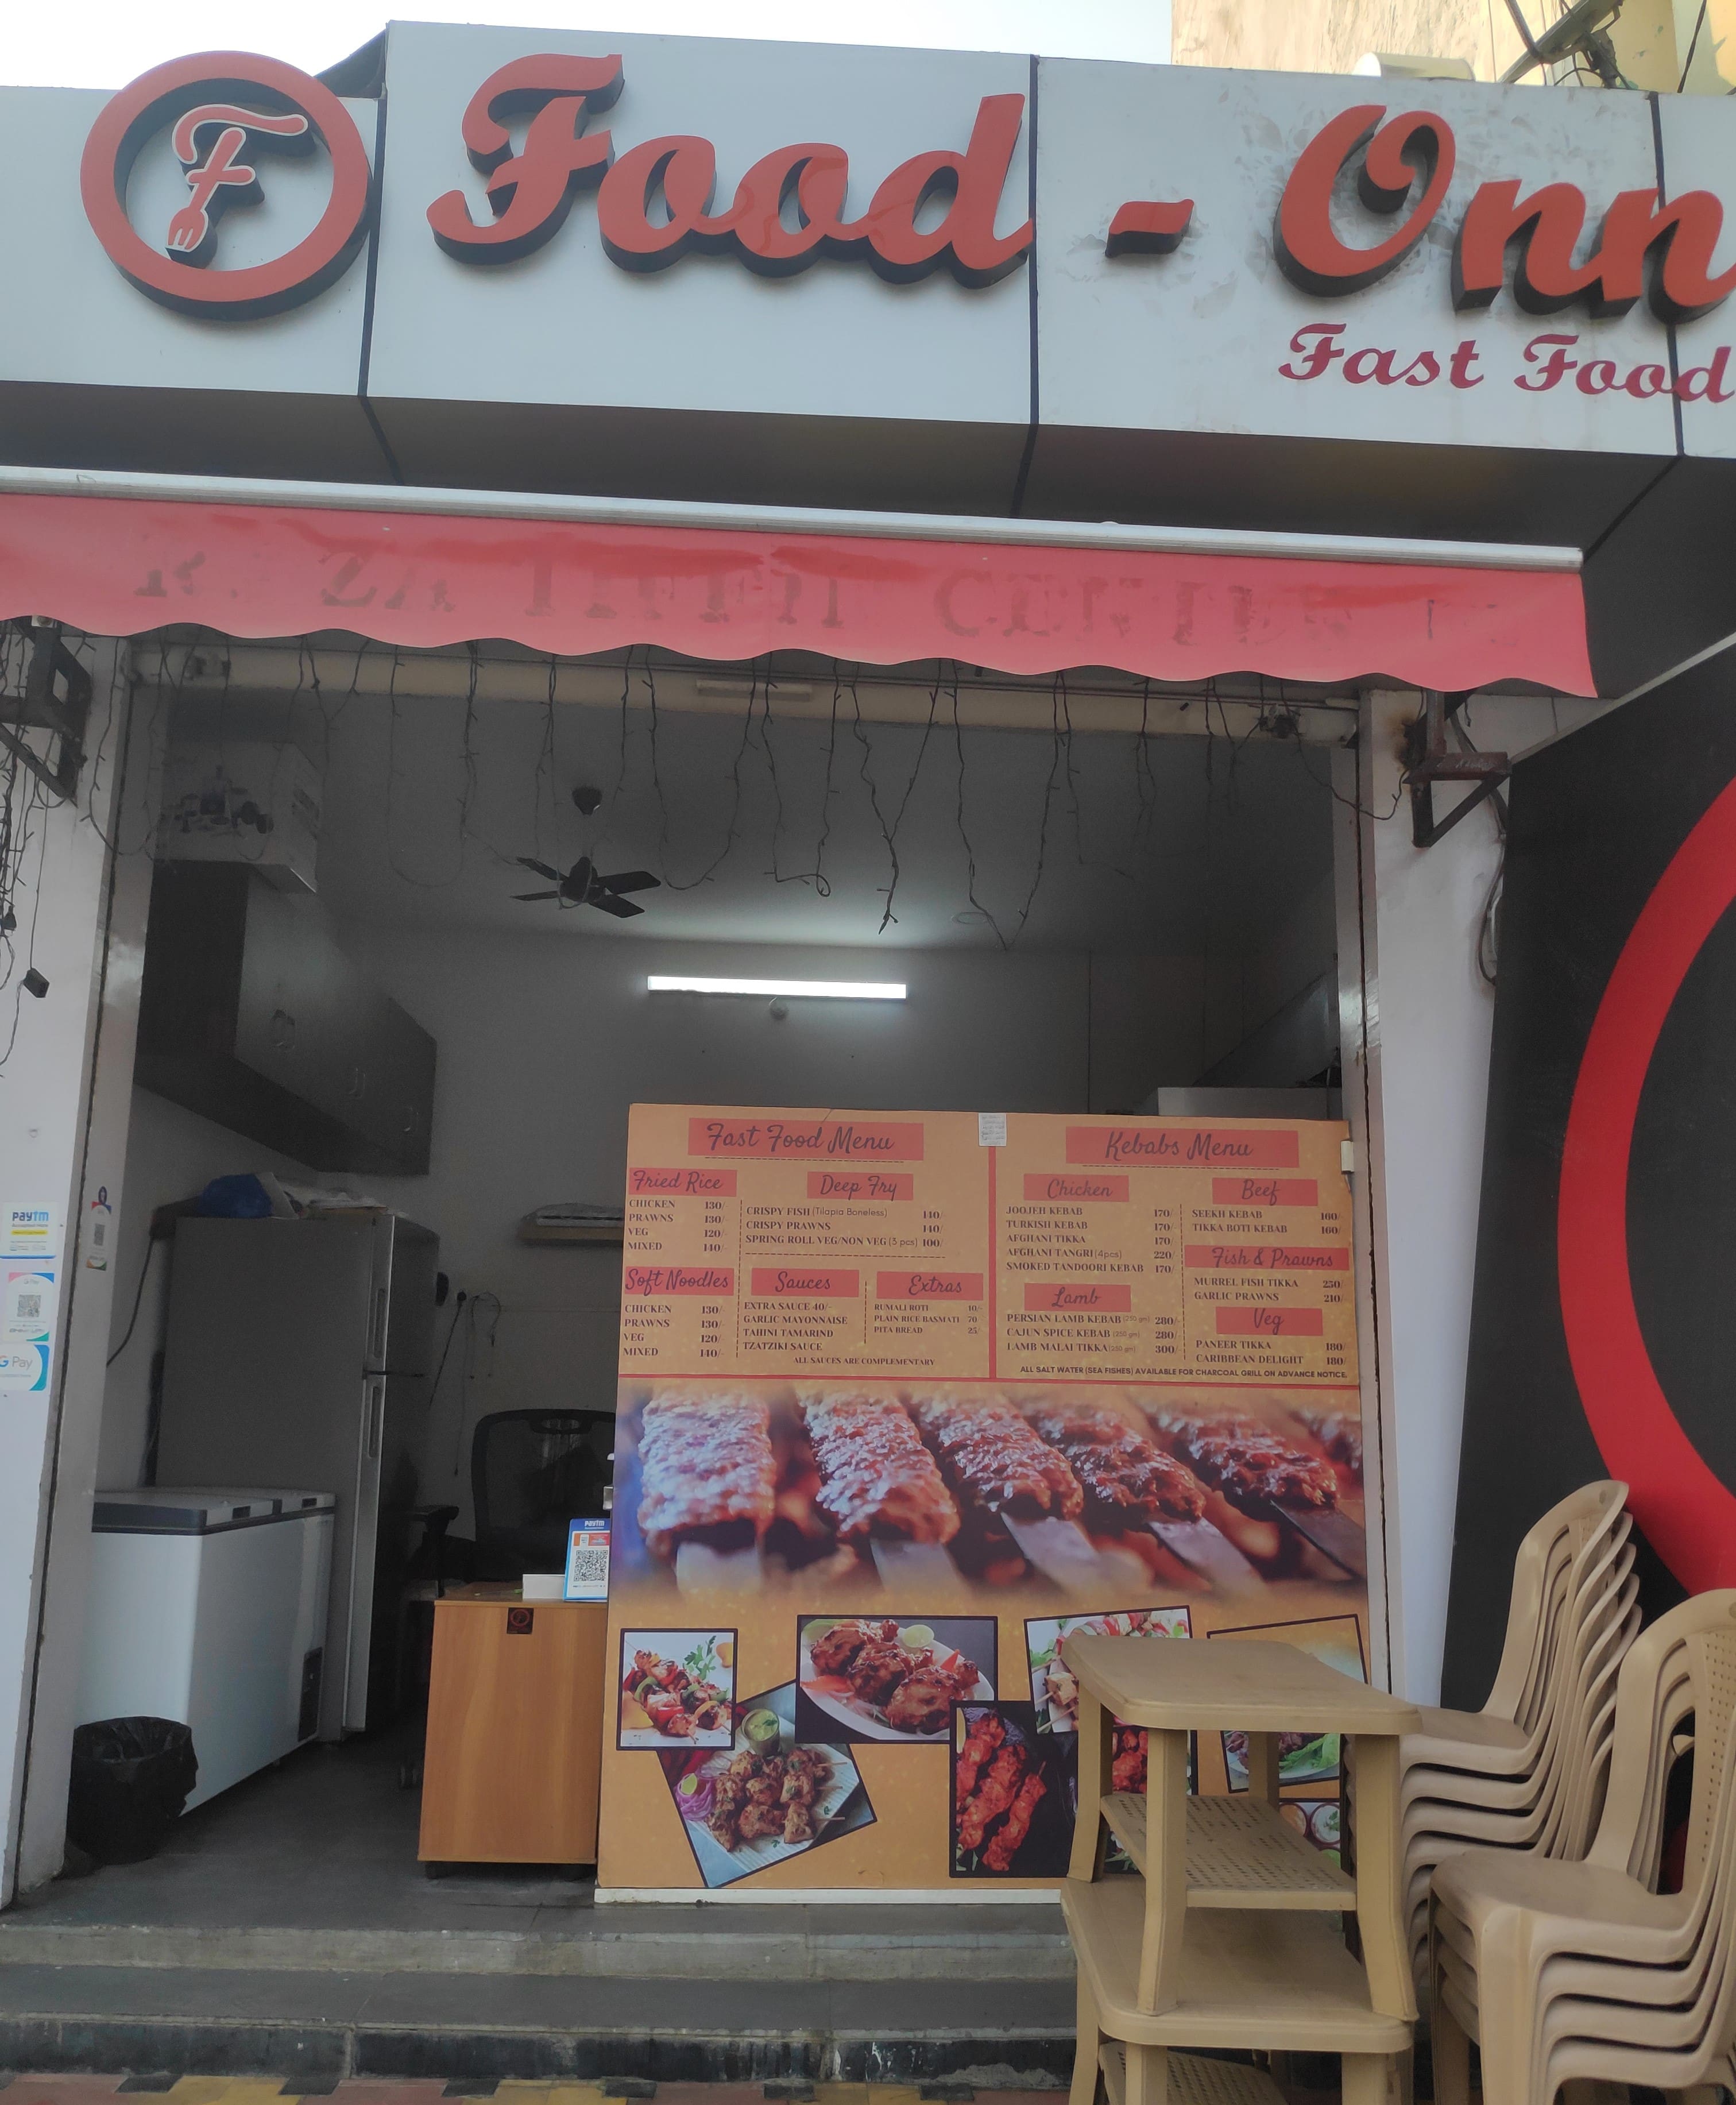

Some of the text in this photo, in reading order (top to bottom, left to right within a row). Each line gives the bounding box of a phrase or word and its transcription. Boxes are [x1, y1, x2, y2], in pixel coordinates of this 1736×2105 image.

[426, 53, 1033, 276] Food
[1277, 105, 1736, 310] Onn
[1279, 323, 1735, 403] Fast Food
[706, 1123, 895, 1154] Fast Food Menu
[1105, 1130, 1254, 1161] Kebabs Menu
[633, 1170, 723, 1194] Fried Rice
[820, 1175, 897, 1202] Deep Fry
[1047, 1178, 1113, 1199] Chicken
[1242, 1179, 1281, 1206] Beef
[629, 1199, 675, 1208] CHICKEN
[746, 1207, 782, 1216] CRISPY
[787, 1208, 810, 1216] FISH
[812, 1208, 844, 1217] (Tilapia
[846, 1208, 887, 1218] Boneless)
[1006, 1206, 1046, 1215] JOOJEH
[1049, 1207, 1082, 1215] KEBAB
[1192, 1210, 1225, 1218] SEEKH
[1229, 1210, 1262, 1218] KEBAB
[629, 1213, 674, 1222] PRAWNS
[746, 1221, 782, 1230] CRISPY
[787, 1222, 831, 1231] PRAWNS
[1006, 1220, 1050, 1229] TURKISH
[1054, 1221, 1088, 1229] KEBAB
[1193, 1223, 1223, 1232] TIKKA
[1227, 1224, 1250, 1232] BOTI
[1254, 1225, 1287, 1233] KEBAB
[628, 1227, 649, 1236] VEG
[745, 1235, 784, 1244] SPRING
[787, 1235, 814, 1245] ROLL
[818, 1236, 864, 1245] VEG/NON
[867, 1237, 887, 1245] VEG
[1007, 1234, 1051, 1242] AFGHANI
[1055, 1235, 1085, 1243] TIKKA
[628, 1242, 662, 1250] MIXED
[1007, 1248, 1052, 1257] AFGHANI
[1055, 1249, 1093, 1257] TANGRI
[1212, 1247, 1333, 1268] Fish & Prawns
[1007, 1262, 1050, 1271] SMOKED
[1054, 1263, 1107, 1272] TANDOORI
[1110, 1264, 1144, 1272] KEBAB
[625, 1268, 729, 1296] Soft Noodles
[775, 1270, 831, 1292] Sauces
[908, 1274, 962, 1296] Extras
[1194, 1277, 1237, 1286] MURREL
[1241, 1278, 1264, 1287] FISH
[1267, 1279, 1298, 1287] TIKKA
[1051, 1287, 1101, 1308] Lamb
[1194, 1291, 1232, 1300] GARLIC
[1235, 1292, 1279, 1301] PRAWNS
[625, 1304, 671, 1314] CHICKEN
[744, 1301, 776, 1310] EXTRA
[778, 1302, 810, 1311] SAUCE
[624, 1319, 670, 1328] PRAWNS
[744, 1315, 848, 1324] GARLIC MAYONNAISE
[1007, 1314, 1051, 1322] PERSIAN
[1054, 1315, 1084, 1323] LAMB
[1088, 1315, 1121, 1324] KEBAB
[1253, 1308, 1284, 1335] Veg
[624, 1333, 644, 1341] VEG
[743, 1328, 834, 1338] TAHINI TAMARIND
[1007, 1328, 1040, 1337] CAJUN
[1043, 1328, 1073, 1337] SPICE
[1077, 1329, 1110, 1338] KEBAB
[743, 1342, 822, 1351] TZATZIKI SAUCE
[1007, 1342, 1037, 1351] LAMB
[1040, 1343, 1073, 1351] MALAI
[1077, 1343, 1108, 1352] TIKKA
[1196, 1340, 1236, 1349] PANEER
[1240, 1341, 1271, 1349] TIKKA
[623, 1347, 659, 1356] MIXED
[12, 1356, 33, 1370] Pay
[861, 1358, 935, 1366] COMPLEMENTARY
[1196, 1354, 1256, 1364] CARIBBEAN
[1259, 1355, 1304, 1364] DELIGHT
